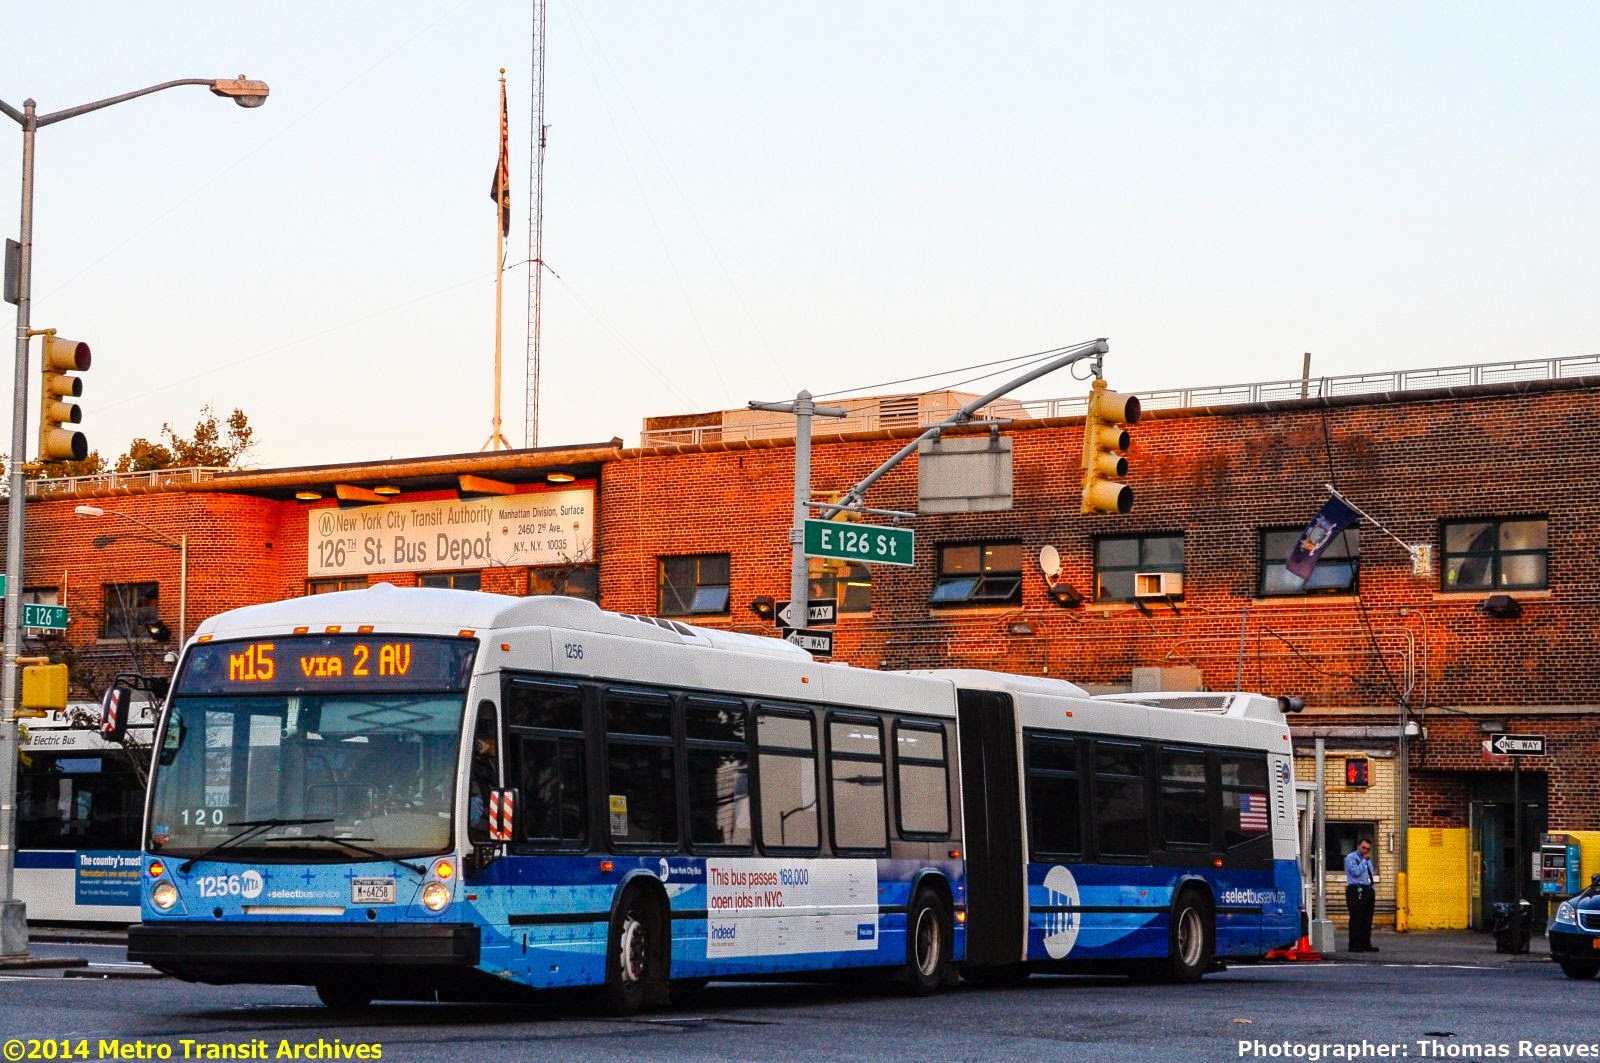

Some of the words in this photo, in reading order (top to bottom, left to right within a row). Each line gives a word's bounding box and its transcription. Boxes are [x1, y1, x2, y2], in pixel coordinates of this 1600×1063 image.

[336, 514, 357, 532] New
[361, 511, 382, 531] York
[387, 510, 406, 532] City
[411, 507, 443, 527] Transit
[447, 504, 493, 526] Authority
[499, 508, 530, 520] Manhattan
[533, 506, 558, 518] Division,
[560, 504, 585, 516] Surface
[518, 523, 535, 535] 2460
[364, 536, 386, 566] St.
[394, 535, 427, 564] Bus
[436, 531, 492, 566] Depot
[547, 539, 568, 551] 10035
[821, 528, 833, 550] E
[838, 530, 870, 553] 126
[876, 534, 897, 557] St
[25, 607, 31, 624] E
[36, 607, 52, 626] 126
[56, 609, 63, 618] ST
[809, 607, 829, 619] WAY
[790, 636, 805, 647] ONE
[811, 637, 828, 649] WAY
[564, 643, 584, 660] 1256
[229, 643, 275, 681] M15
[301, 656, 343, 677] VIA
[353, 644, 370, 677] 2
[379, 643, 412, 676] AV
[34, 734, 61, 746] Electric
[62, 735, 76, 745] Bus
[1499, 740, 1515, 749] ONE
[1521, 740, 1539, 750] WAY
[80, 854, 92, 866] The
[92, 854, 124, 869] country's
[124, 855, 141, 866] most
[670, 867, 679, 875] New
[679, 867, 687, 875] York
[694, 867, 702, 875] Bus
[711, 867, 729, 886] This
[731, 868, 747, 886] bus
[748, 871, 778, 889] passes
[779, 868, 809, 889] 168,000
[196, 874, 240, 898] 1256
[711, 895, 733, 913] open
[734, 891, 753, 913] jobs
[754, 891, 763, 908] in
[764, 890, 785, 908] NYC.
[711, 921, 736, 940] indeed
